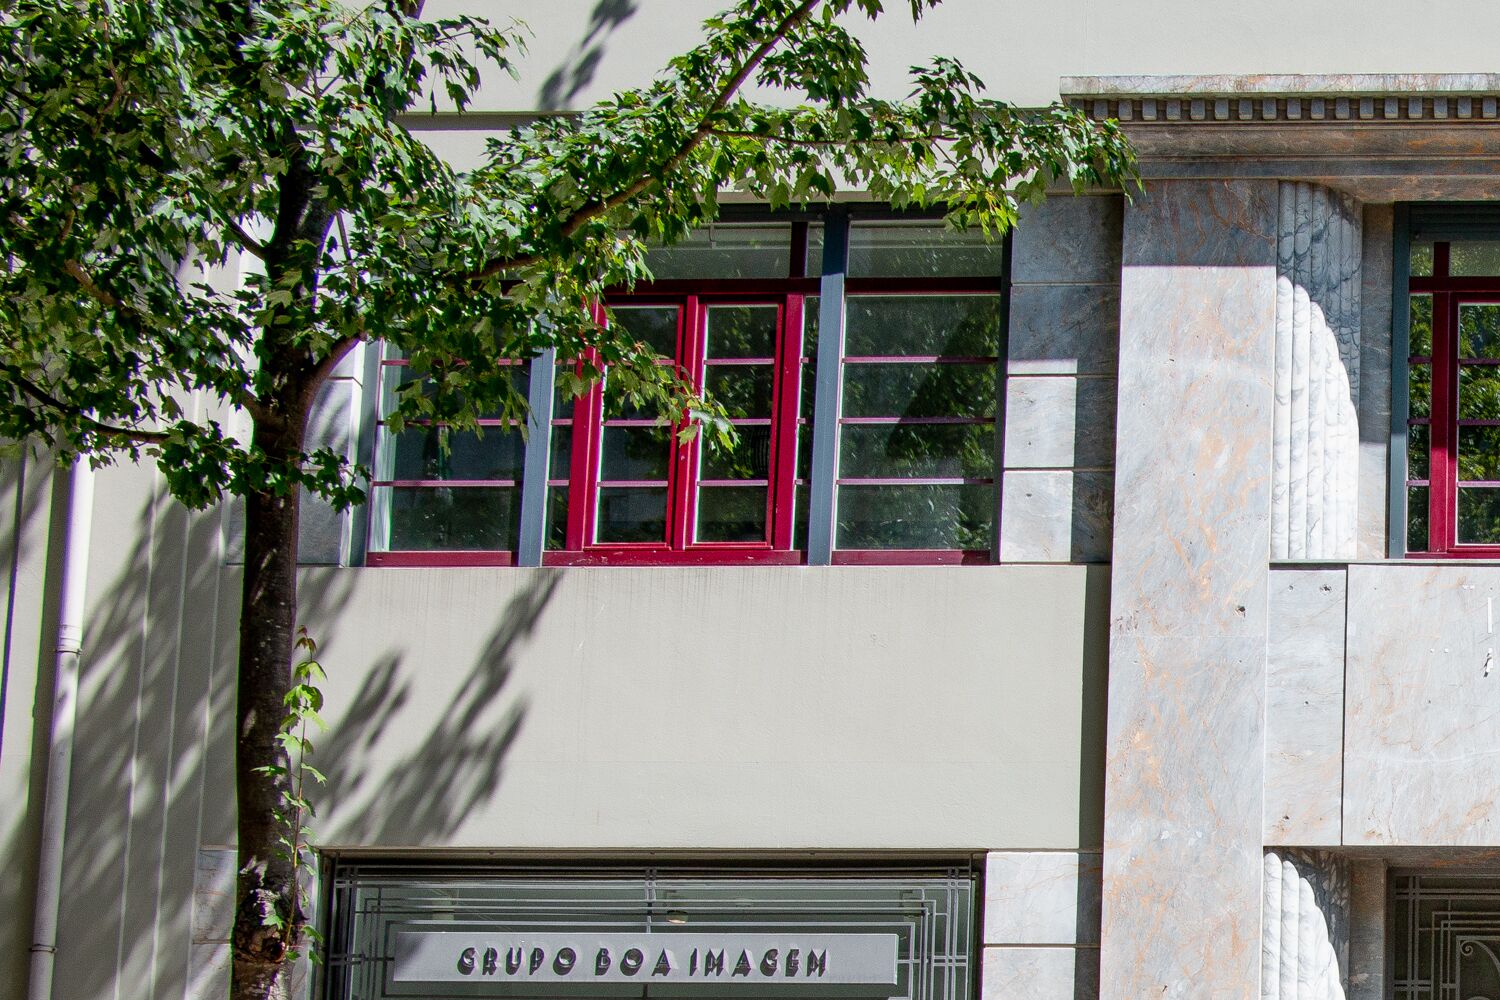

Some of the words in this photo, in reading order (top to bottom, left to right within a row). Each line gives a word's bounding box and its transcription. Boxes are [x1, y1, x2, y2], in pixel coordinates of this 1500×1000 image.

[456, 947, 577, 976] GRUPO
[594, 947, 673, 976] BOA
[688, 947, 828, 977] IMAGEM
